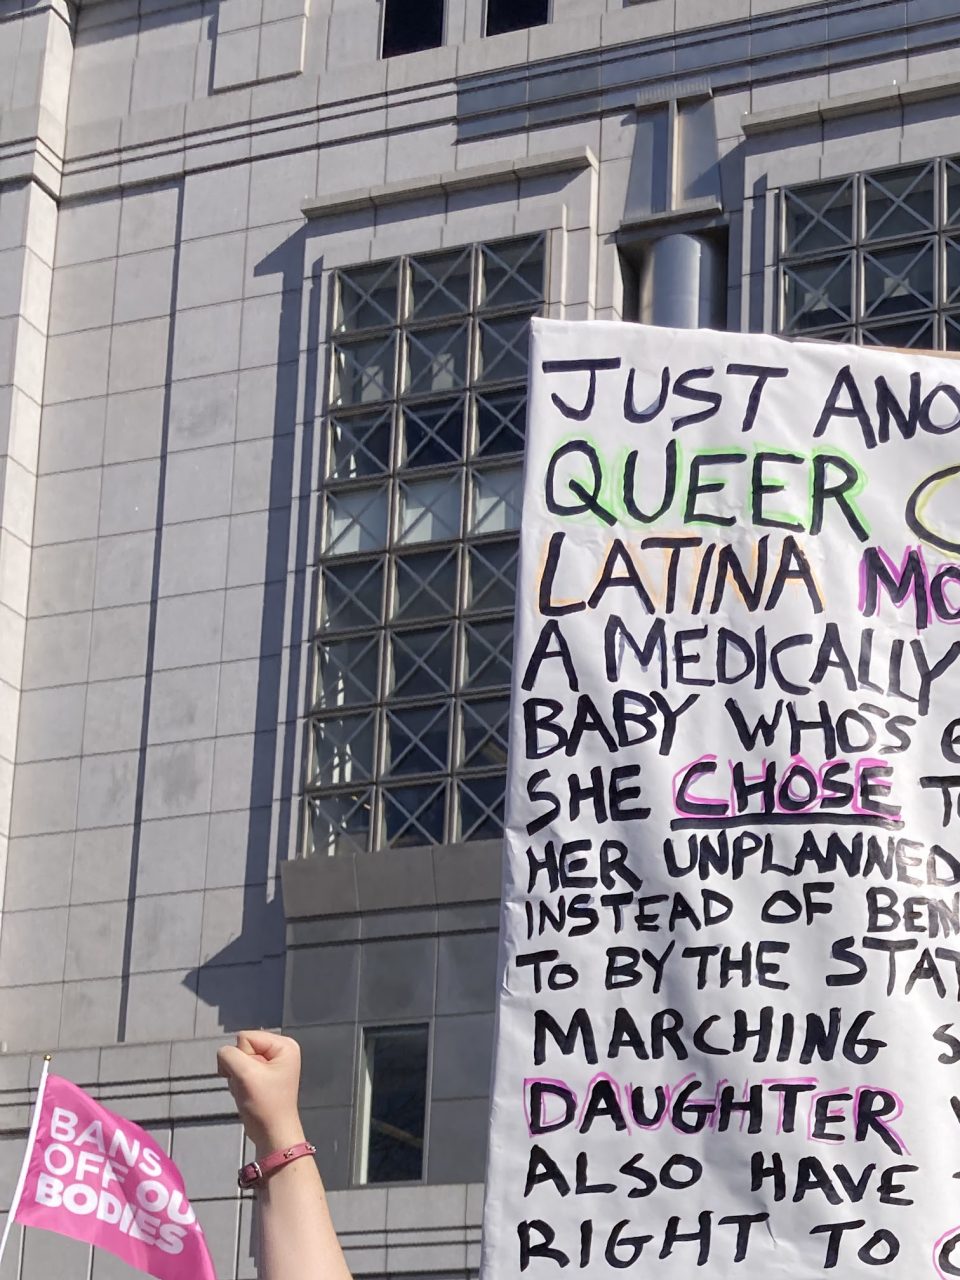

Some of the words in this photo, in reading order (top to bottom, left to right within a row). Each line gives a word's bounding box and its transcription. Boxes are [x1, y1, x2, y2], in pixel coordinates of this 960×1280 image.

[542, 358, 787, 430] JUST
[542, 438, 870, 543] QUEER
[539, 532, 824, 617] LATINA
[522, 620, 579, 692] A
[523, 691, 700, 759] BABY
[725, 698, 917, 759] WHO'S
[526, 765, 651, 835] SHE
[675, 760, 904, 817] CHOSE
[527, 840, 642, 893] HER
[526, 890, 732, 939] INSTEAD
[762, 882, 834, 925] OF
[516, 951, 578, 993] TO
[605, 944, 675, 990] BY
[698, 941, 789, 990] THE
[534, 1007, 887, 1065] MARCHING
[51, 1107, 163, 1177] BANS
[530, 1080, 902, 1155] DAUGHTER
[35, 1172, 188, 1255] BODIES
[44, 1143, 129, 1189] OFF
[136, 1180, 203, 1233] OU
[524, 1152, 702, 1198] ALSO
[751, 1155, 918, 1205] HAVE
[518, 1211, 769, 1271] RIGHT
[810, 1220, 899, 1268] TO
